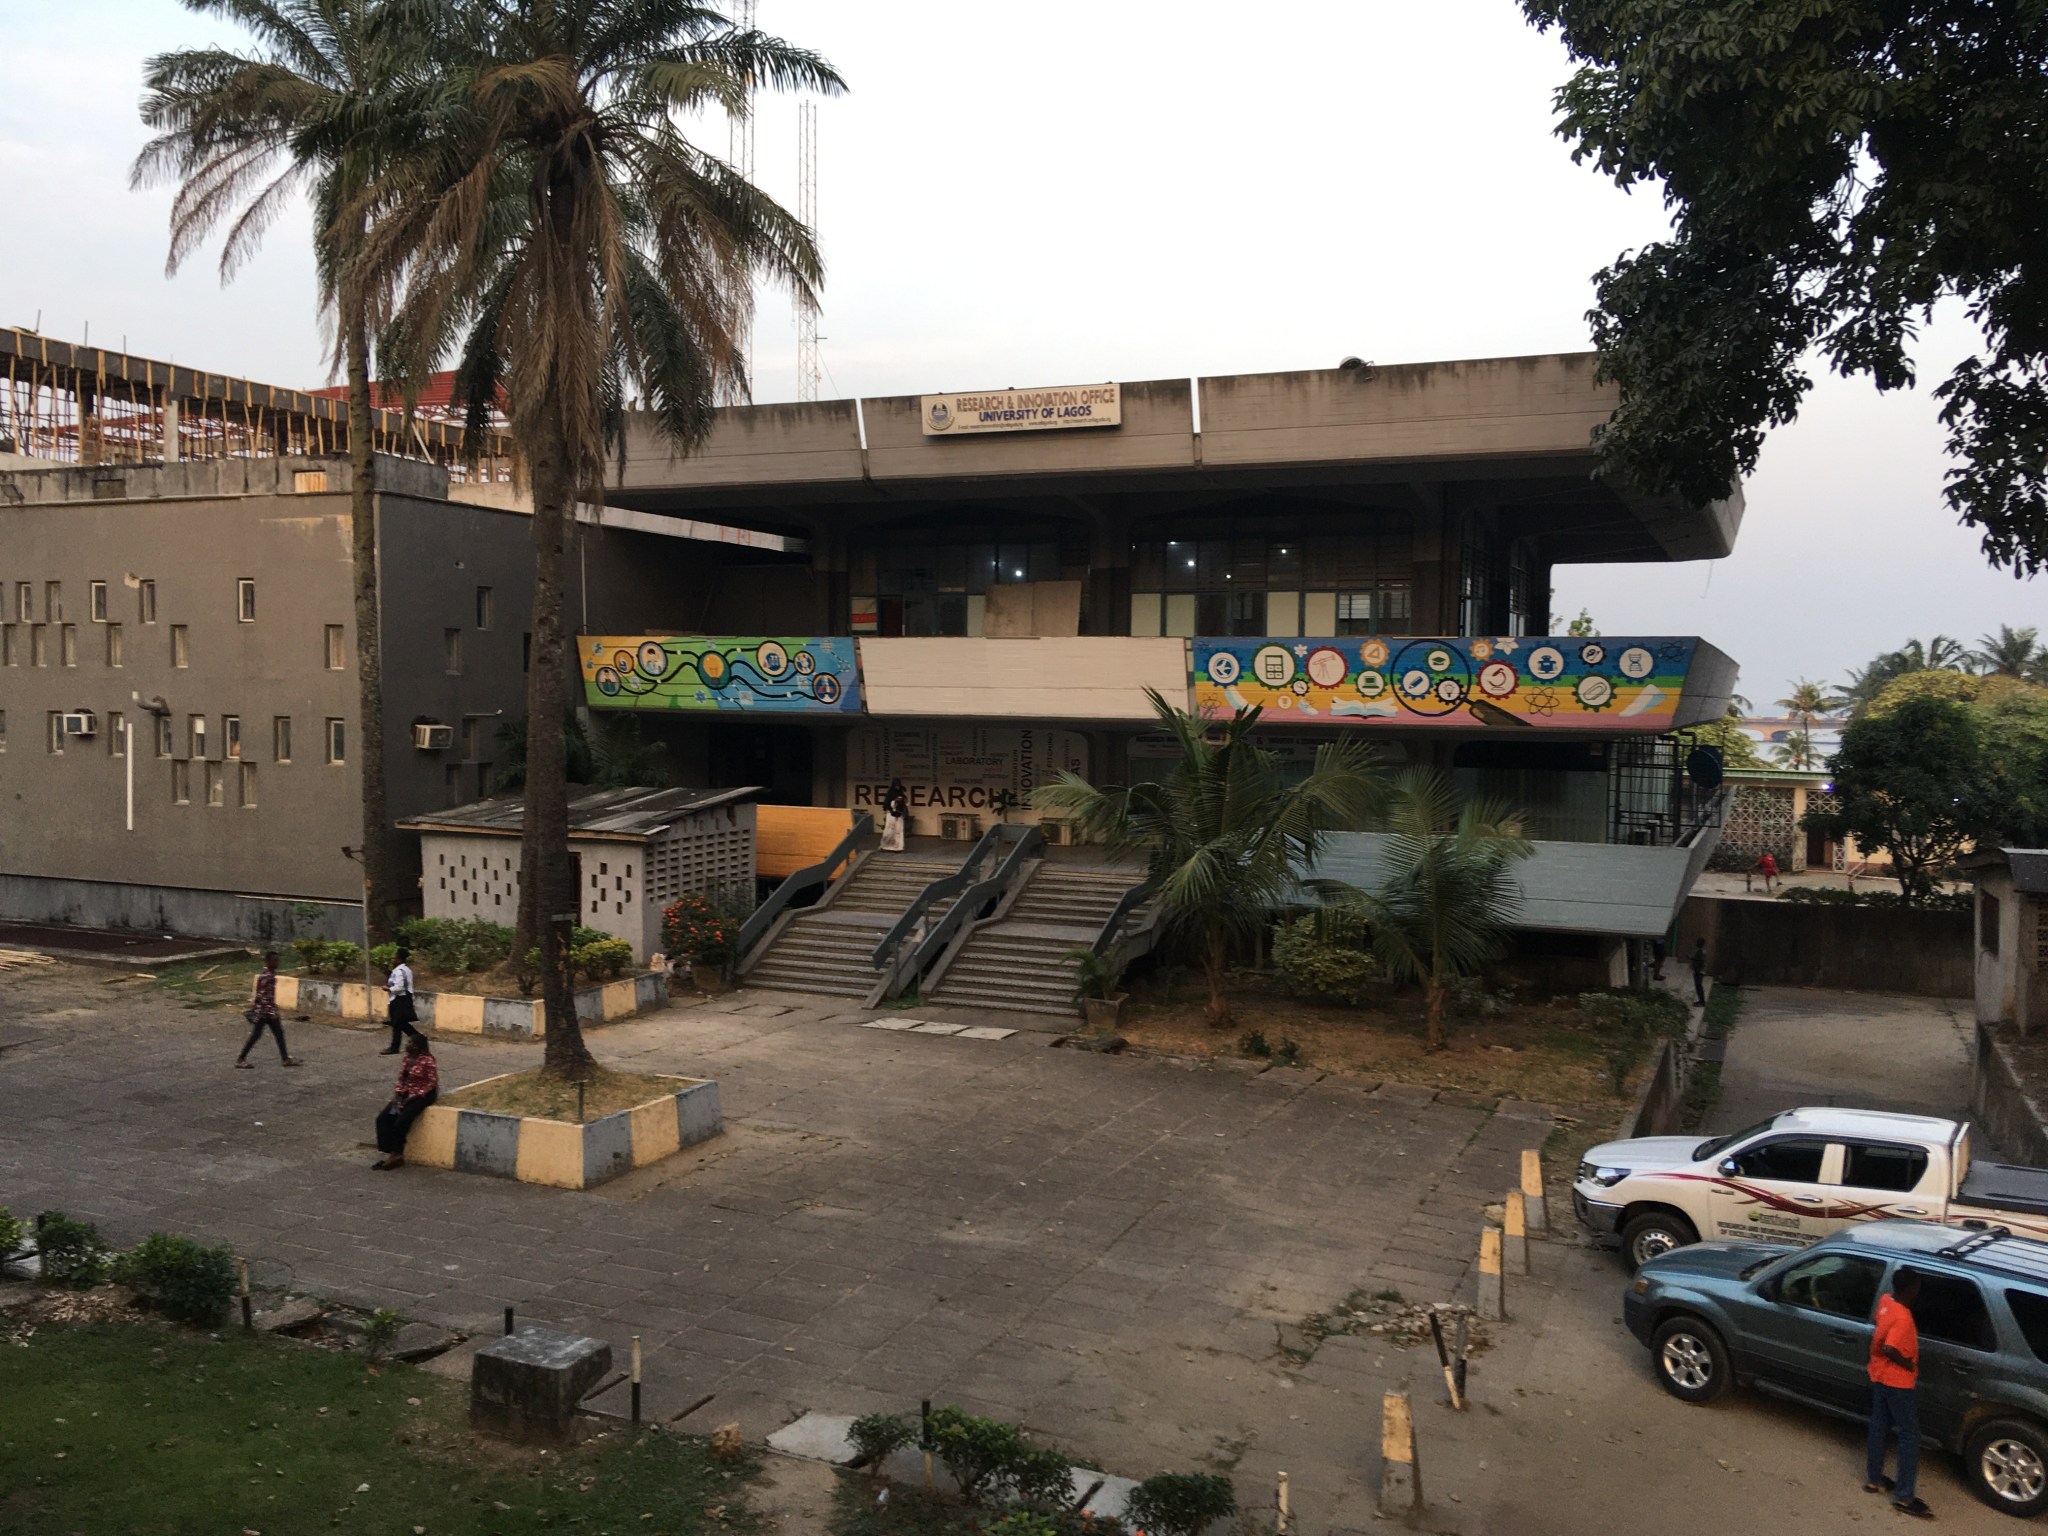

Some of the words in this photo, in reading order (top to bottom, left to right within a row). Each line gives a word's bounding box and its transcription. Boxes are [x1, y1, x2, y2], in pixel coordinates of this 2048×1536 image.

[956, 395, 1005, 412] RESEARCH
[1007, 394, 1015, 410] &
[1017, 391, 1077, 409] INNOVATION
[1082, 388, 1115, 404] OFFICE
[979, 407, 1037, 422] UNIVERSITY
[1042, 406, 1054, 418] OF
[1058, 405, 1092, 417] LAGOS
[945, 757, 1003, 765] LABORATORY
[1021, 729, 1032, 811] INNOVATION
[855, 784, 1008, 809] REEARCH
